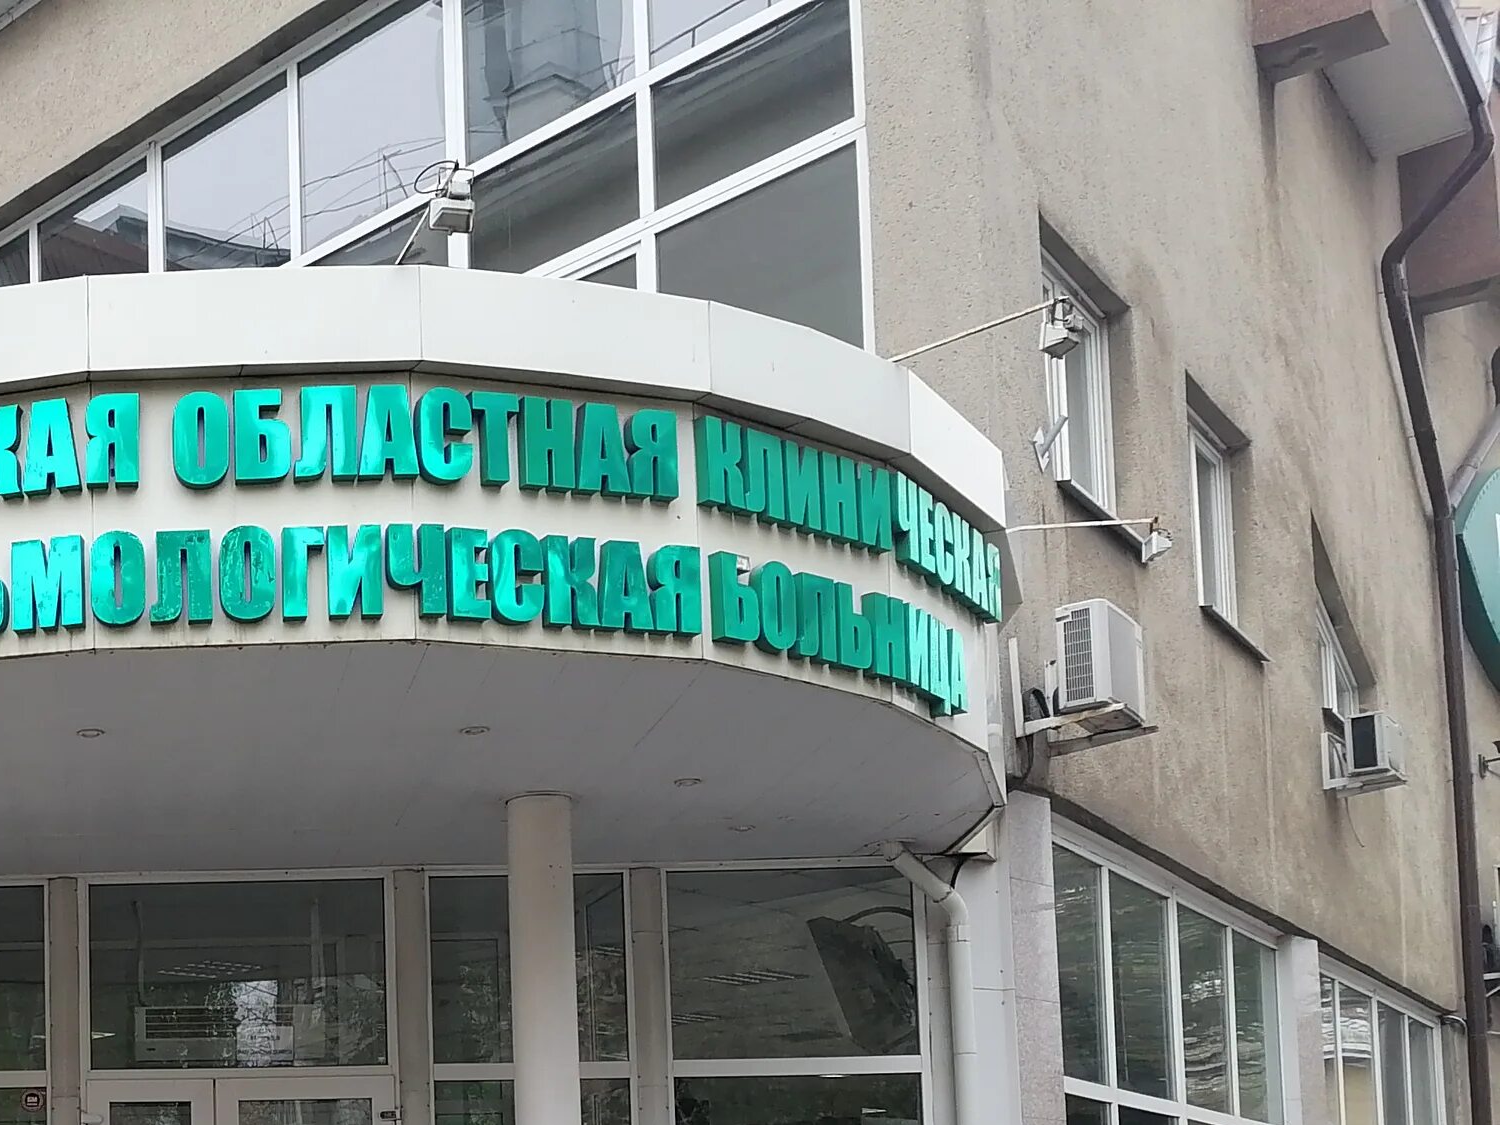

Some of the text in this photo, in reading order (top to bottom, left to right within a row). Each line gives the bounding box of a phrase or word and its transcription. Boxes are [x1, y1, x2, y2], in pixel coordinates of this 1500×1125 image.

[172, 384, 679, 501] ОБЛАСТНАЯ
[697, 416, 1001, 623] КЛИНИЧЕСКАЯ
[709, 550, 968, 717] БОЛЬНИЦА
